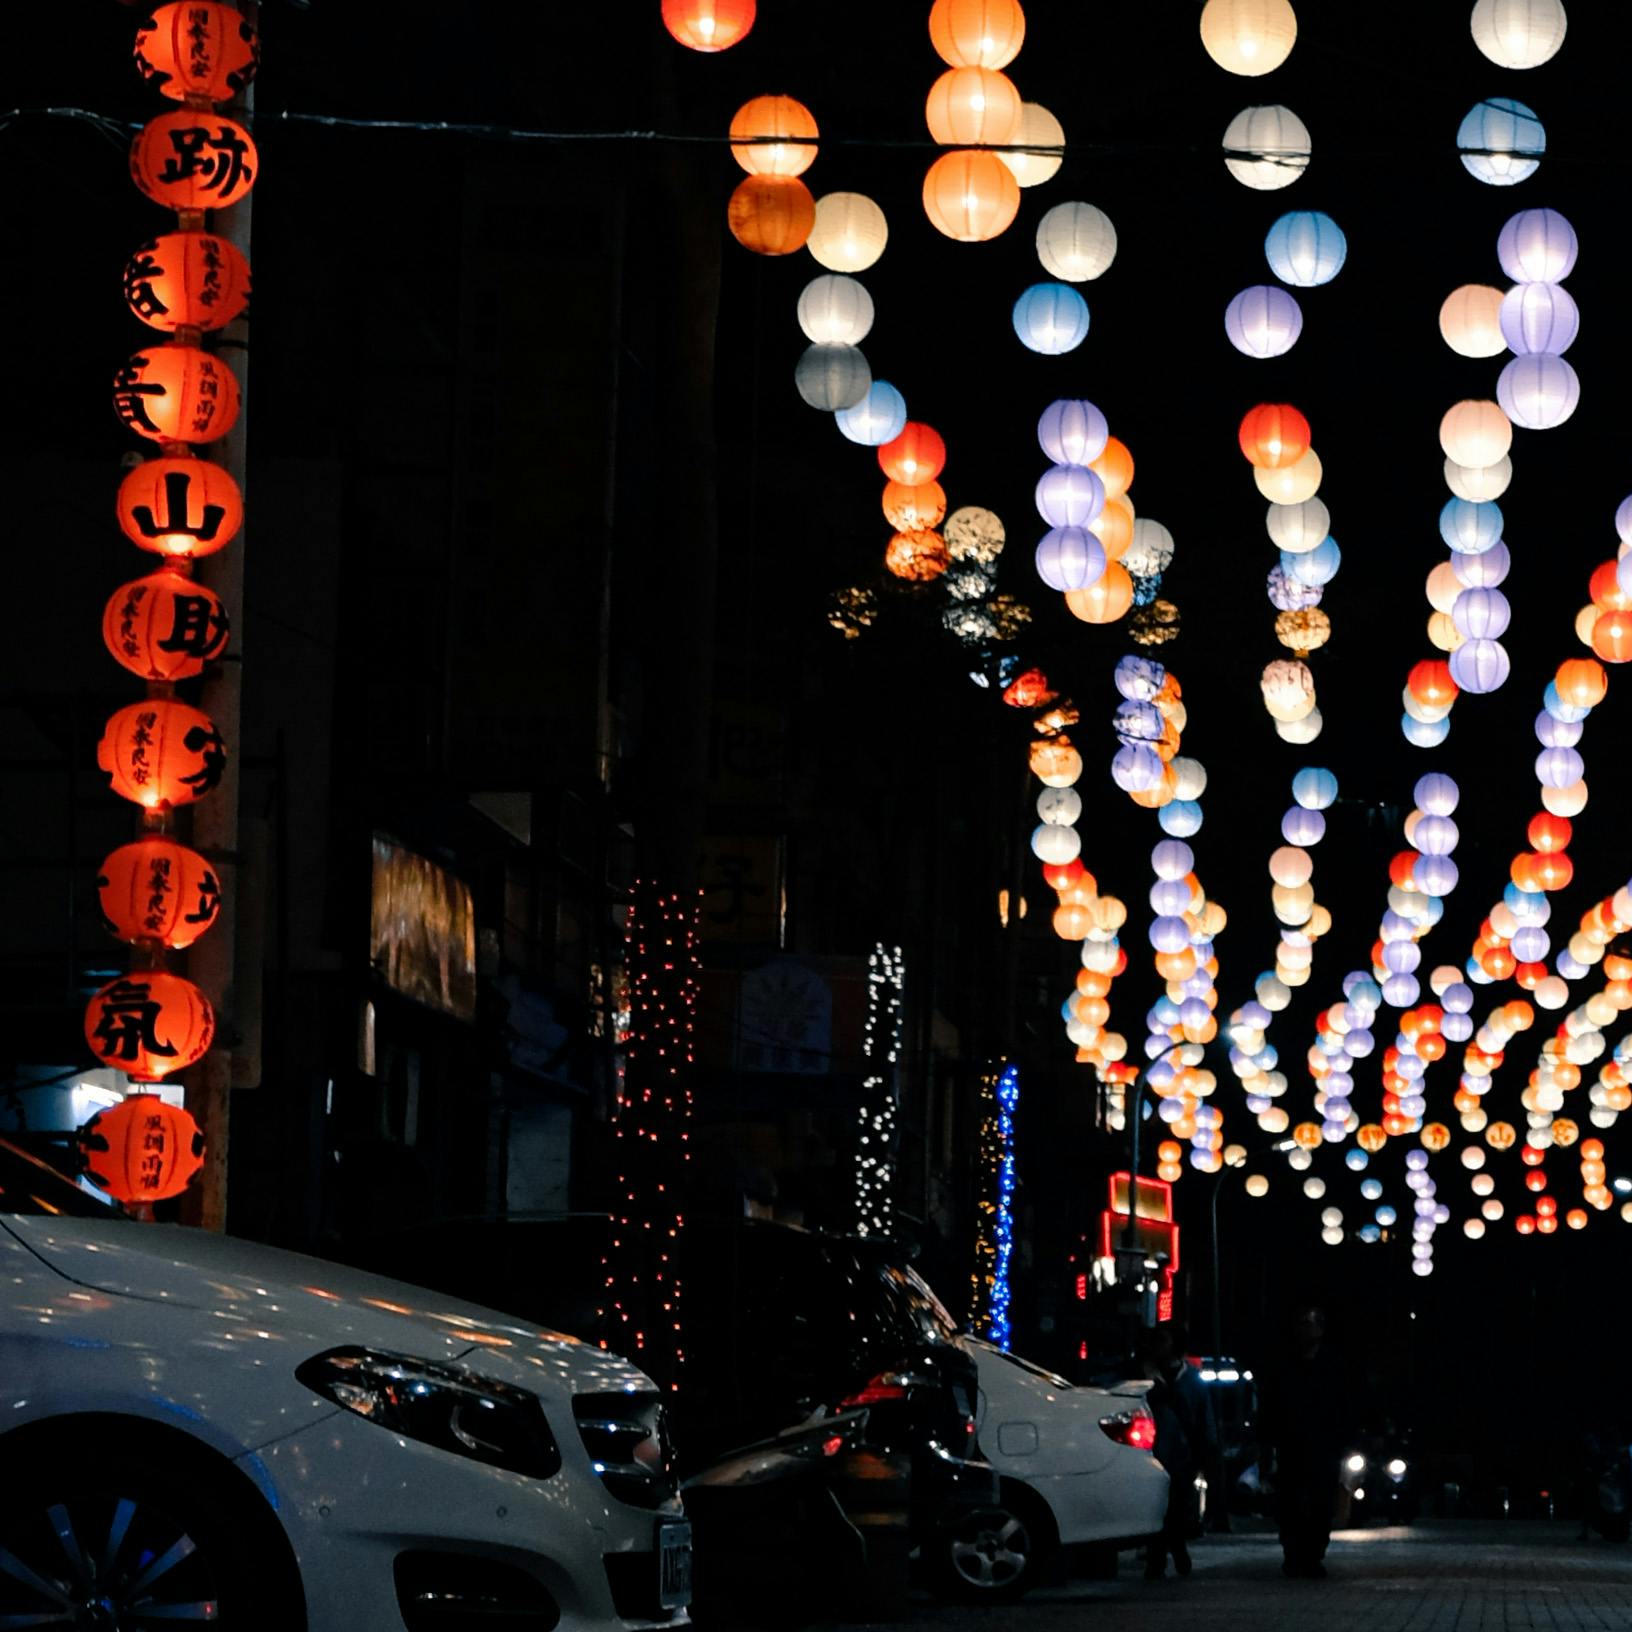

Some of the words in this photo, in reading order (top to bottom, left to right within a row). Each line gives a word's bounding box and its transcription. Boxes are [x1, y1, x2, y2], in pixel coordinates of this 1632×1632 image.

[157, 125, 252, 198] 跡
[131, 471, 226, 541] 山
[92, 980, 179, 1061] 氛
